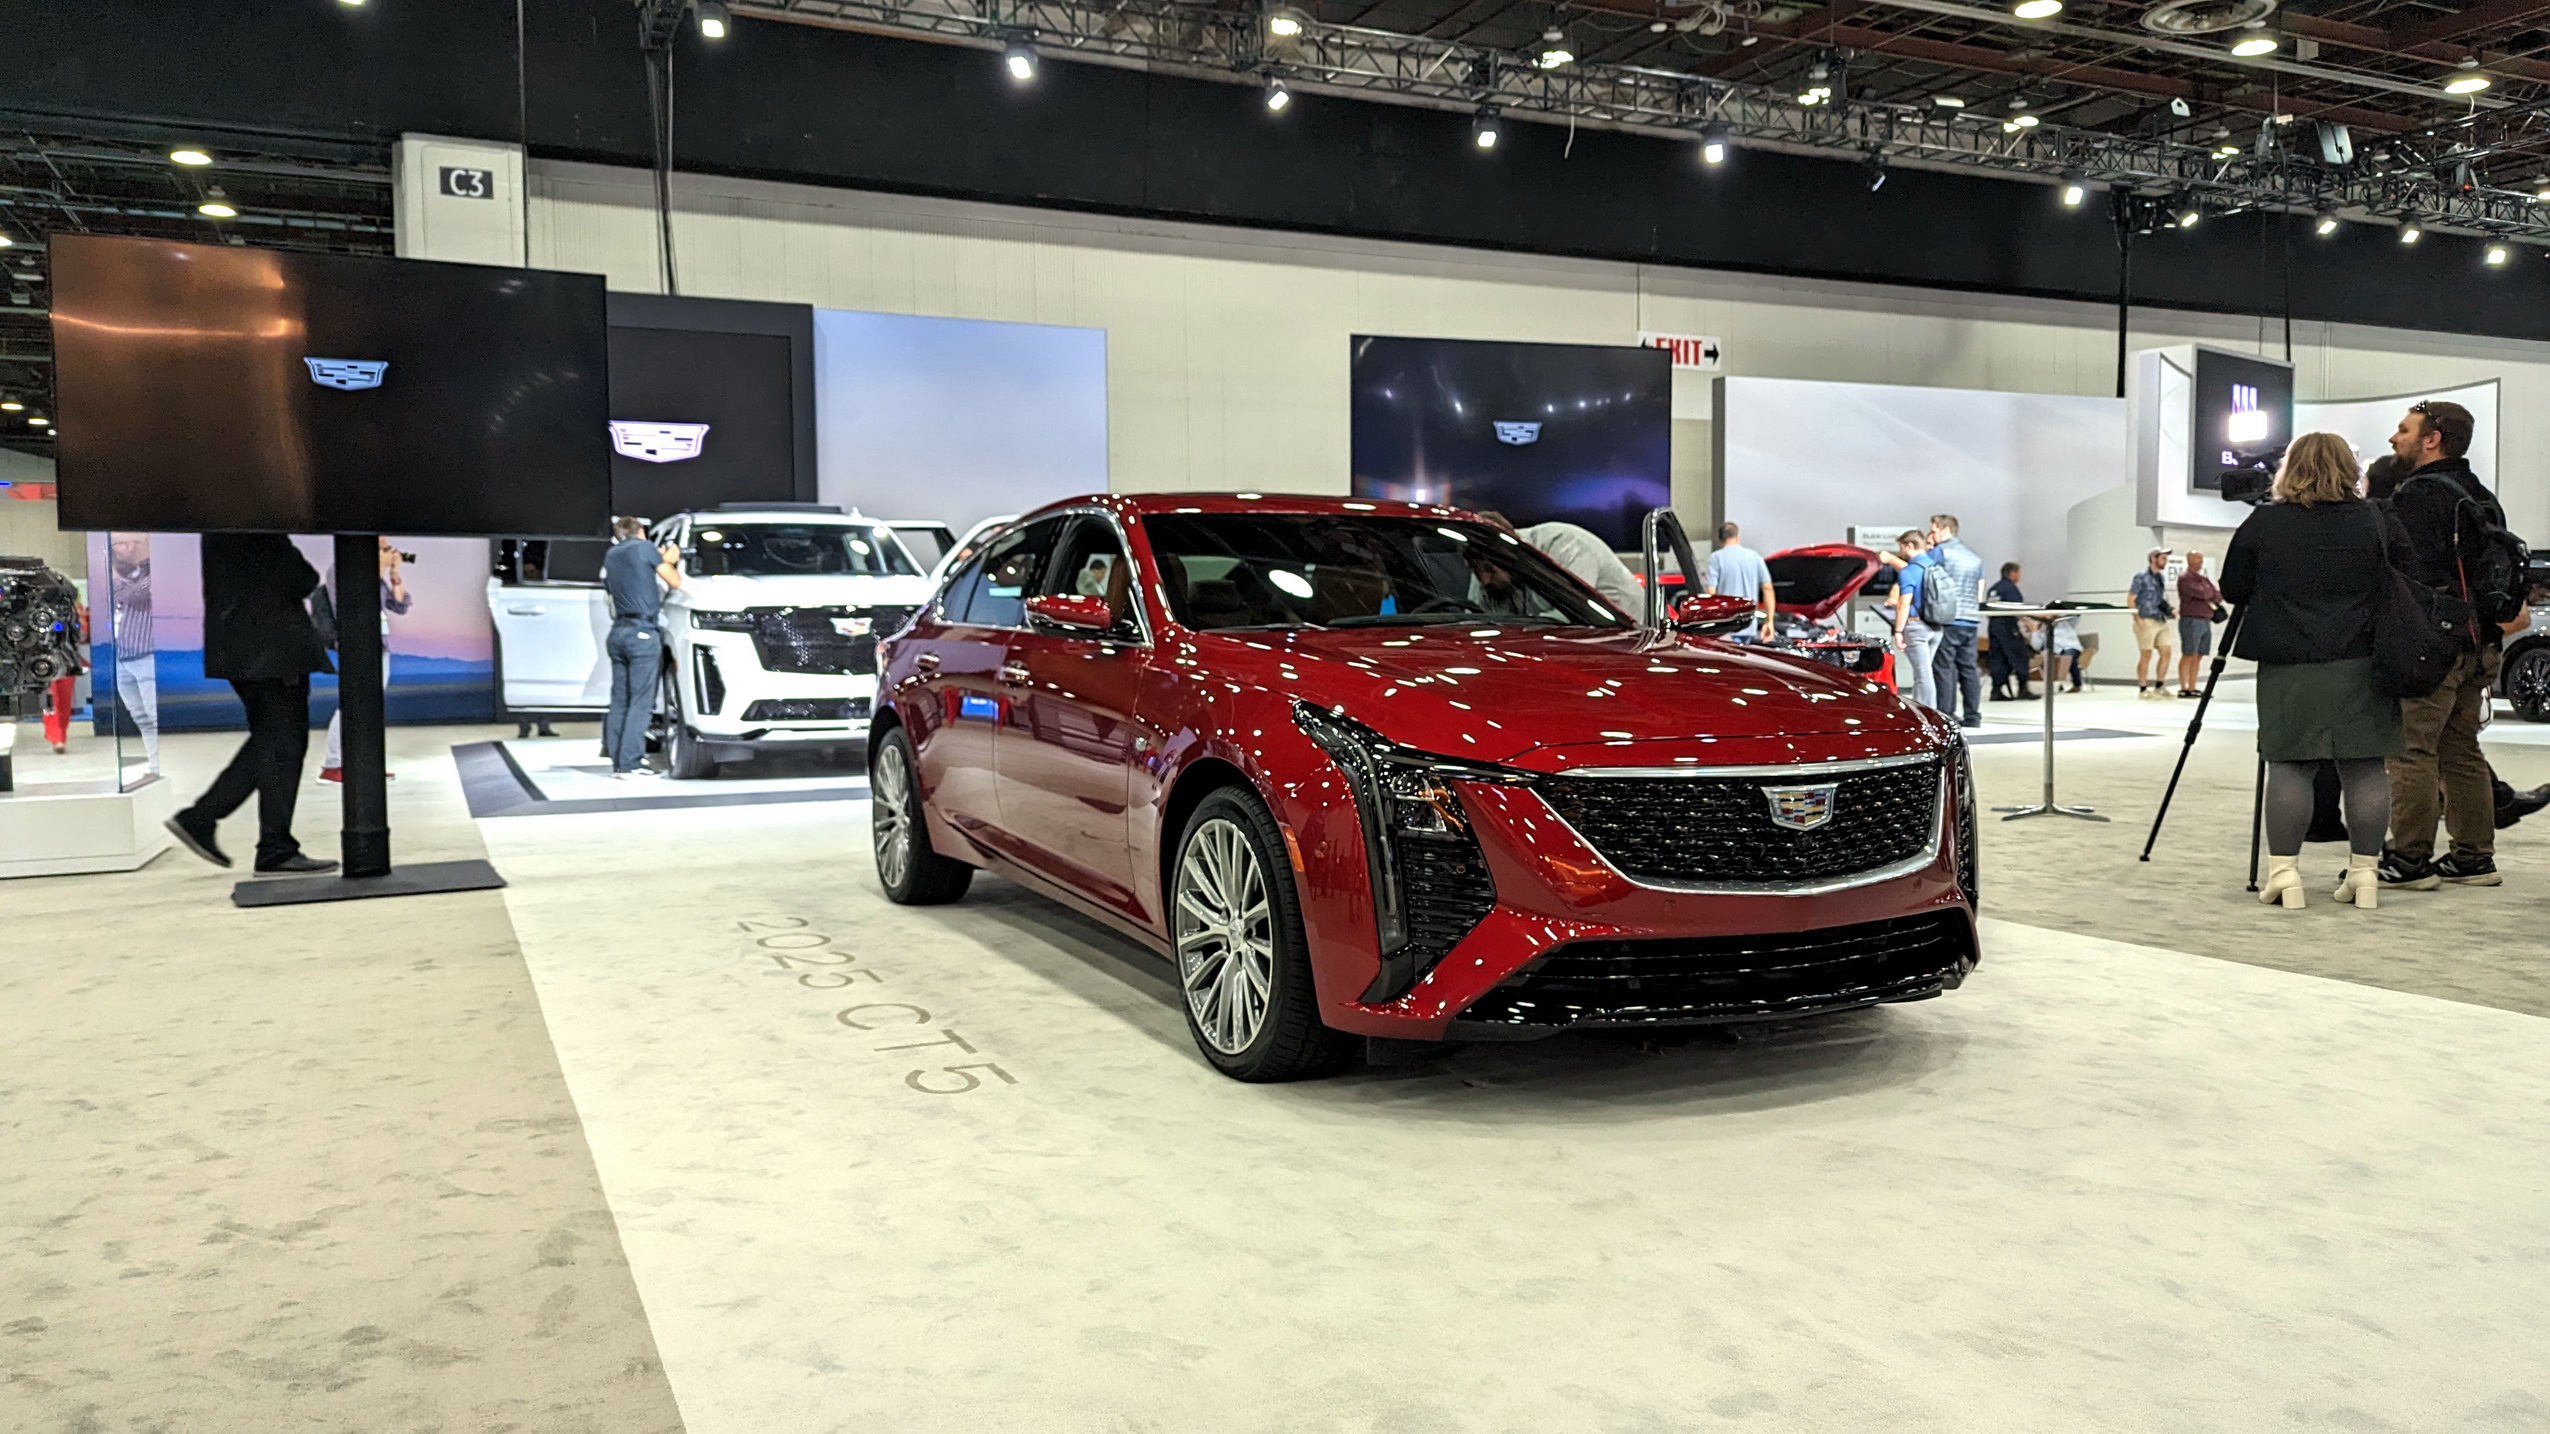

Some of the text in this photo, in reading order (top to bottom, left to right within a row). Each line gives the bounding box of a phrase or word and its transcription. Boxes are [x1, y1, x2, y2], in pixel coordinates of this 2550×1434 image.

[450, 169, 484, 197] C3
[737, 917, 1019, 1094] 2025 CT5
